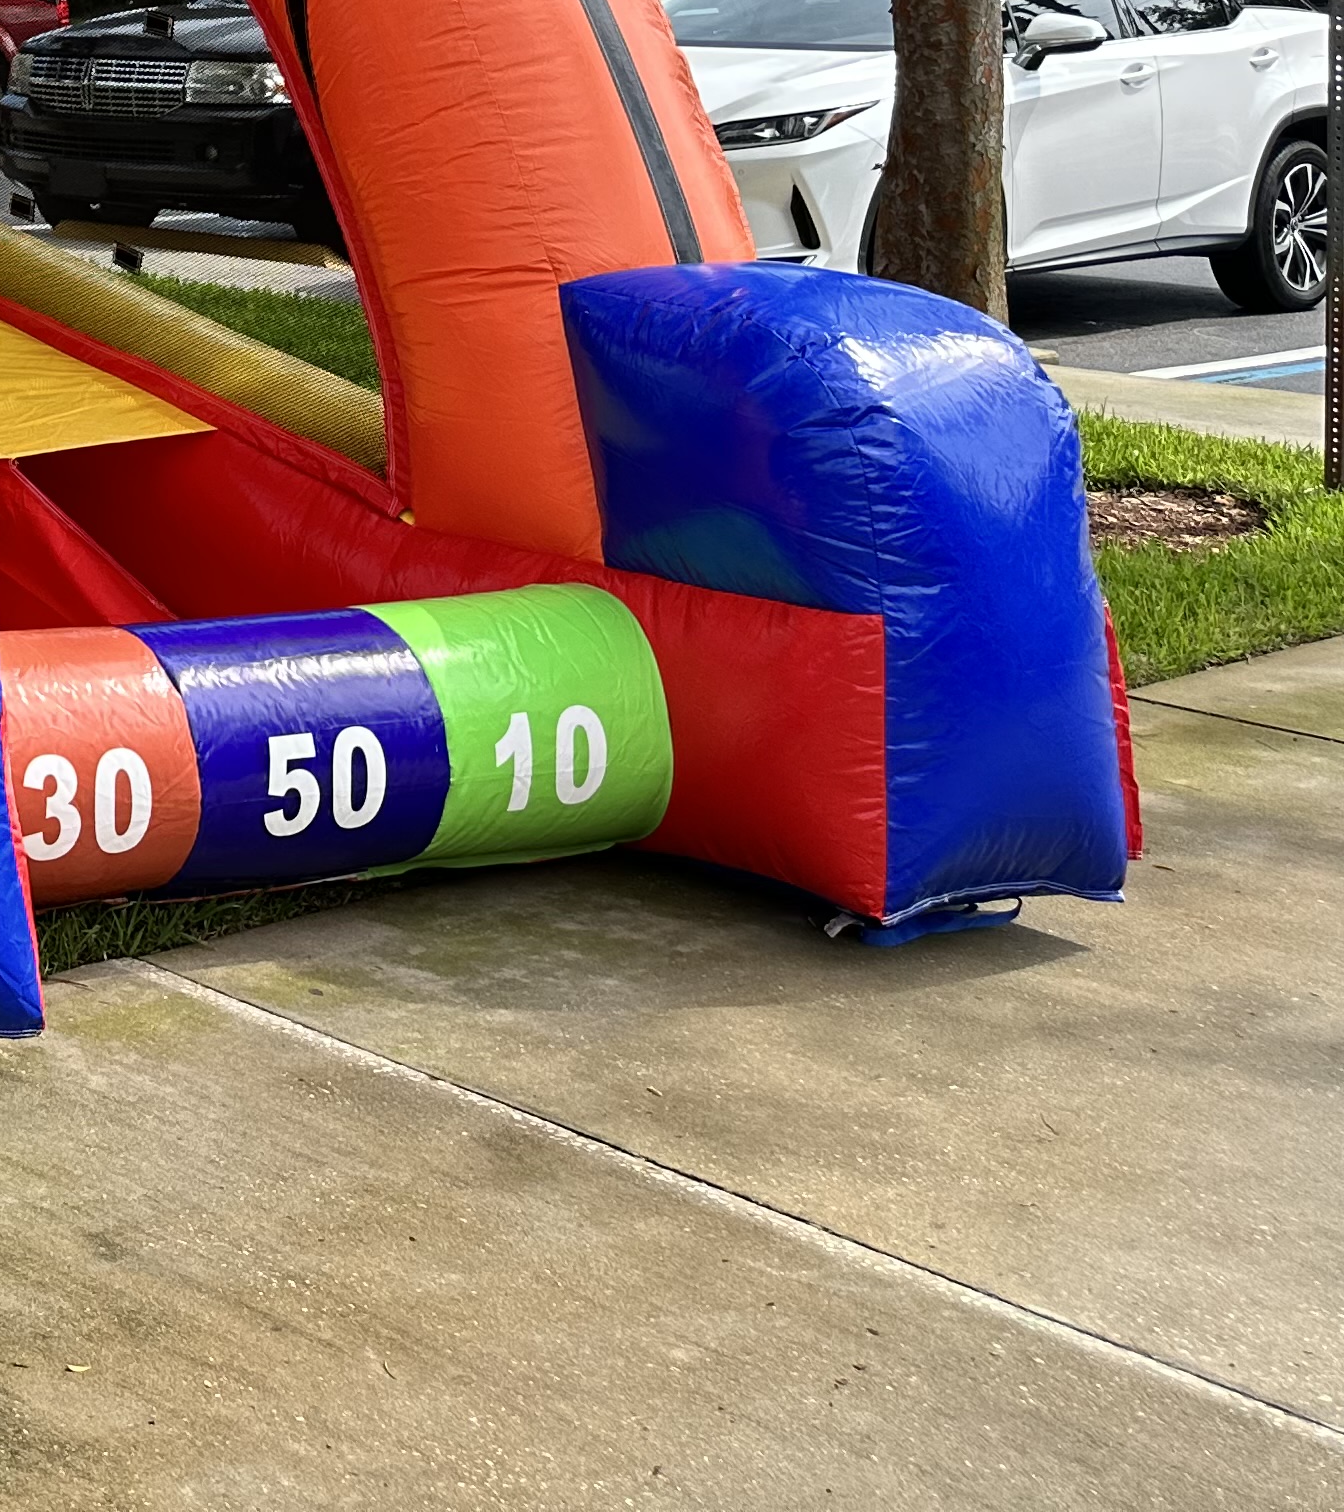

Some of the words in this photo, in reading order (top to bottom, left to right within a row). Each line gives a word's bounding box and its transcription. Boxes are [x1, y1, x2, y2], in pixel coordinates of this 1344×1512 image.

[22, 747, 152, 861] 30
[264, 725, 387, 837] 50
[494, 705, 608, 812] 10
